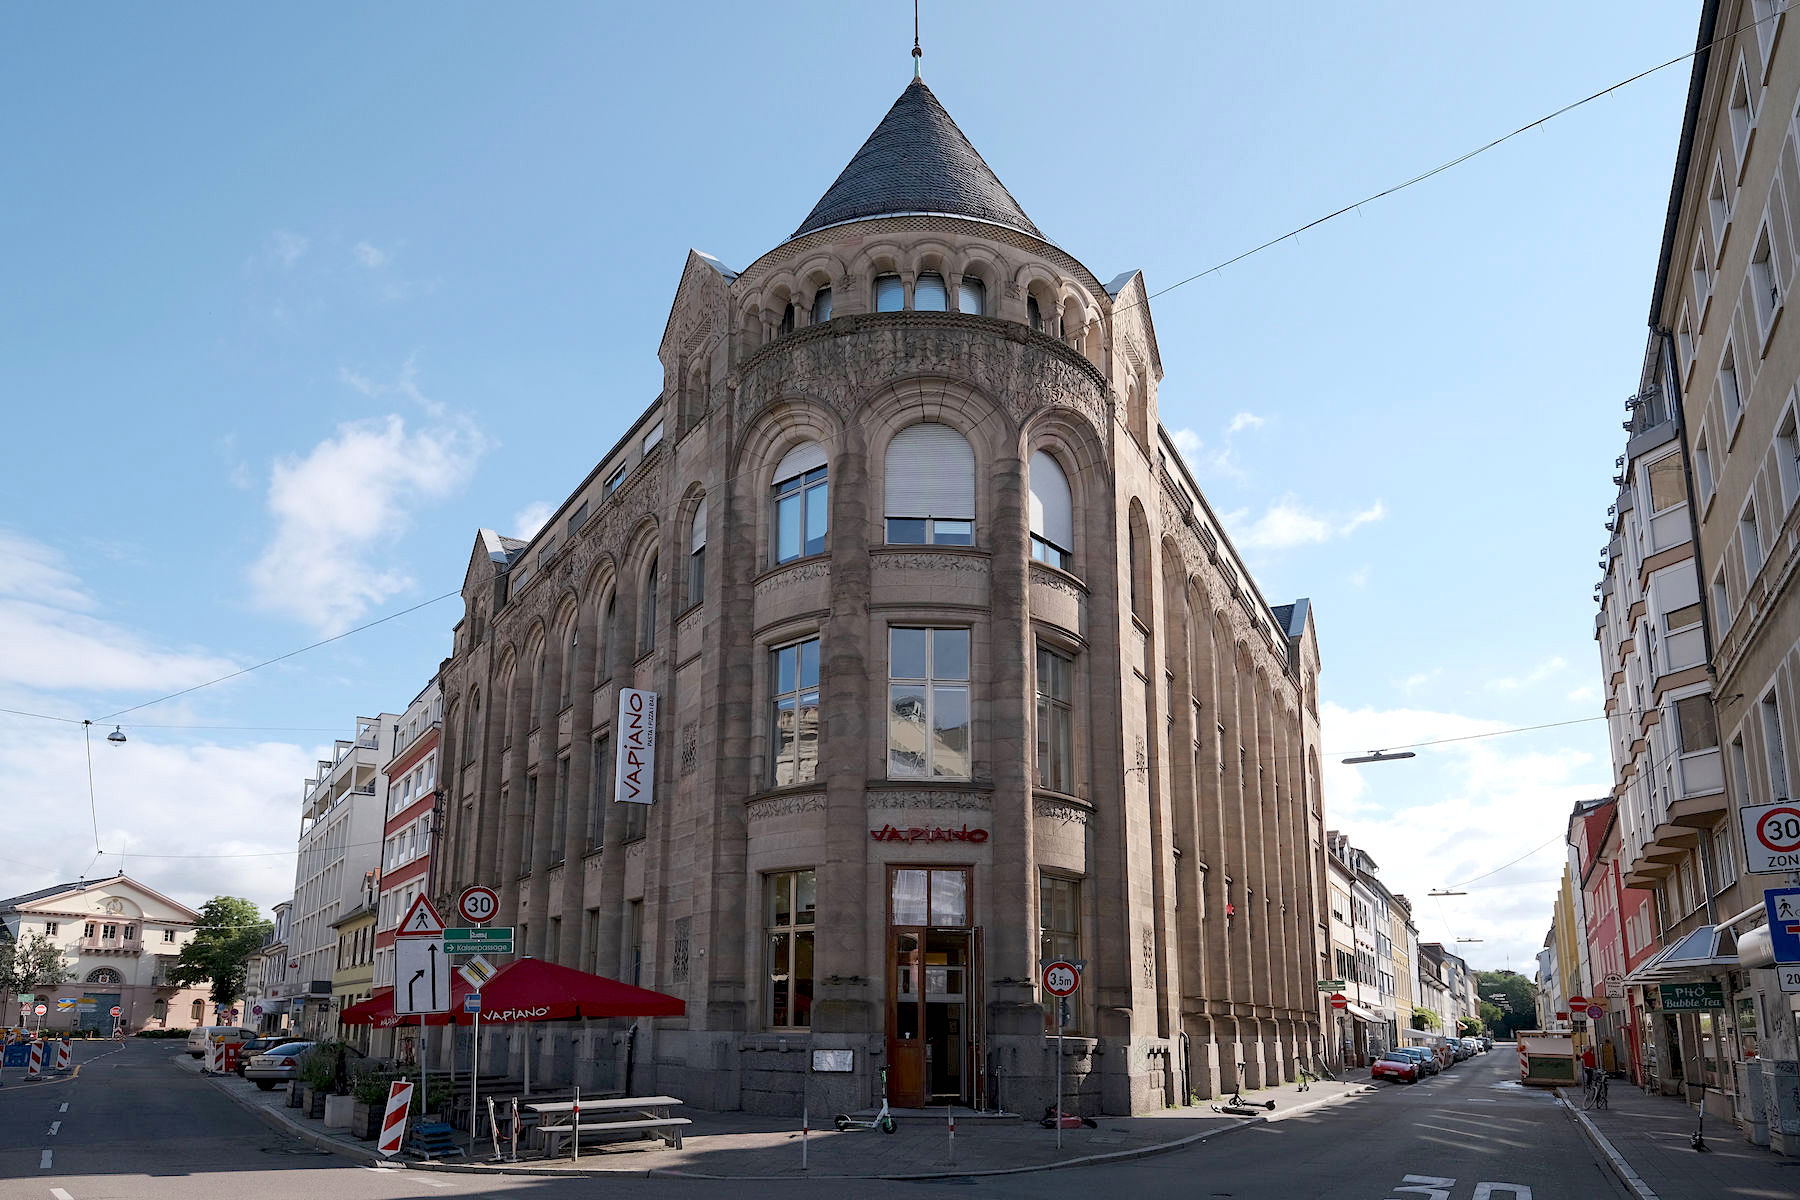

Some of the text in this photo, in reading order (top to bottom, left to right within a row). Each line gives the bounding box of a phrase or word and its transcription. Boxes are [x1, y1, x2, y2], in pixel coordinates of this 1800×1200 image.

[623, 692, 645, 798] VAPIANO
[870, 823, 989, 846] VAPIANO
[1767, 818, 1800, 840] 30
[467, 897, 491, 913] 30
[456, 944, 508, 953] Kaiserpassage
[1664, 997, 1721, 1008] Bubble Tea
